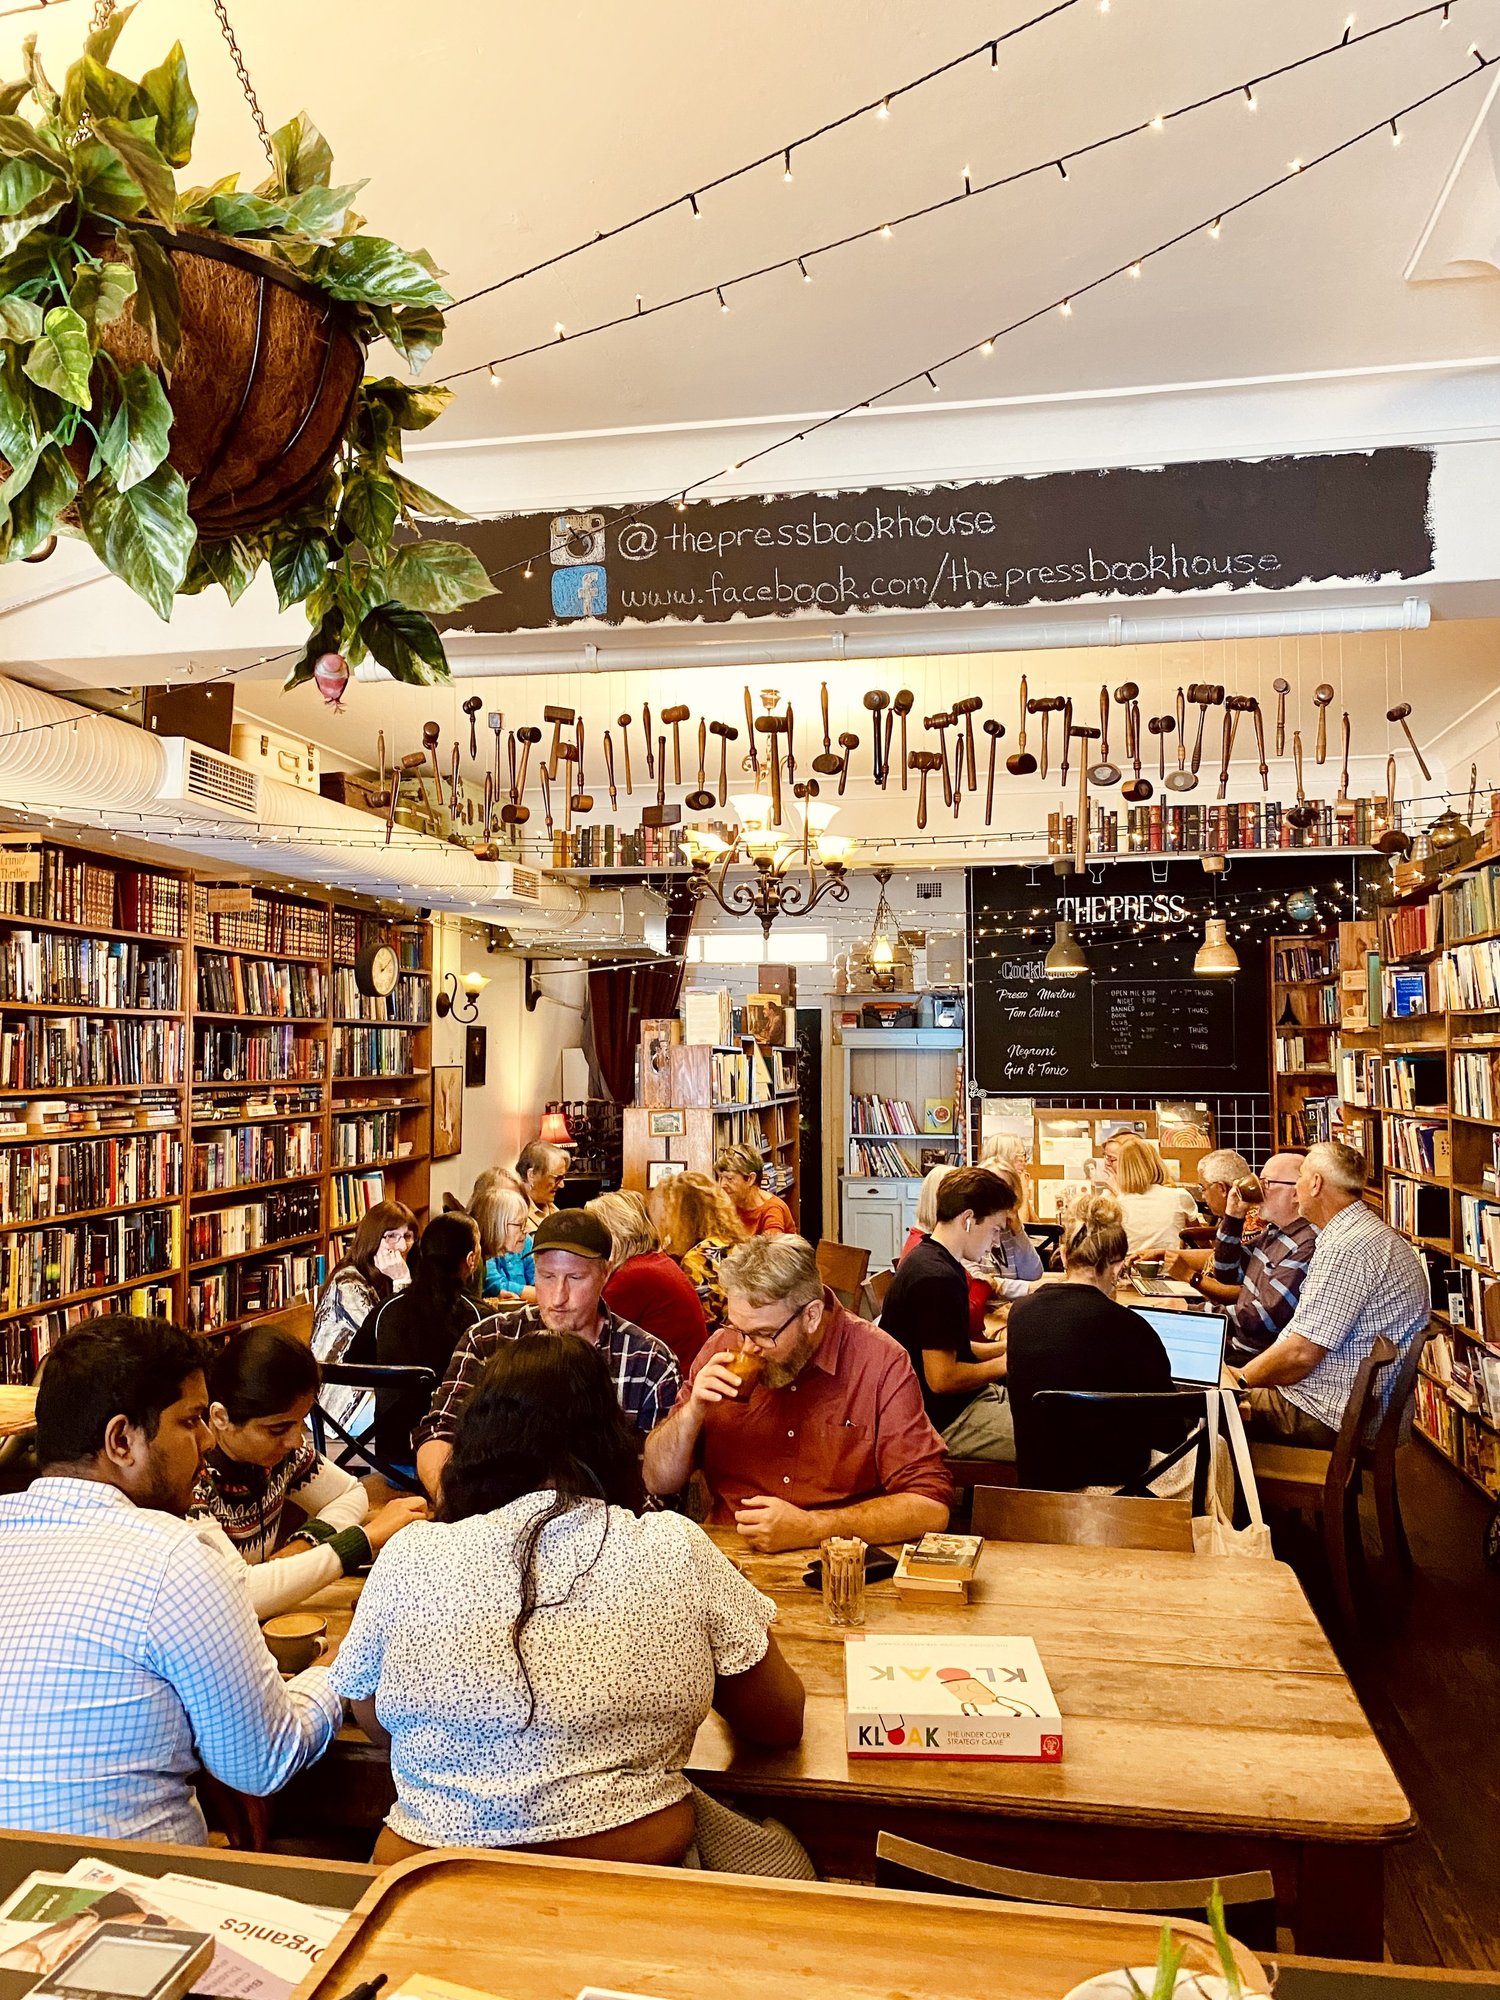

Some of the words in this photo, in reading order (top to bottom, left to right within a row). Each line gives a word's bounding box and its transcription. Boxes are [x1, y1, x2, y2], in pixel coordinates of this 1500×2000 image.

[620, 543, 1283, 609] www.facebook.com/thepressbookhouse
[1056, 896, 1108, 924] THE
[1109, 894, 1185, 923] PRESS
[1036, 988, 1077, 1000] Martini
[1110, 989, 1128, 997] OPEN
[1004, 1007, 1026, 1021] Tom
[1028, 1006, 1061, 1018] Collins
[1187, 1007, 1209, 1015] THURS
[1188, 1026, 1208, 1034] THURS
[1007, 1044, 1057, 1060] Negroni
[1004, 1062, 1024, 1080] Gin
[1027, 1063, 1036, 1076] &
[1037, 1062, 1069, 1076] Tonic
[947, 1730, 959, 1738] THE
[960, 1731, 985, 1739] UNDER
[986, 1731, 1011, 1739] COVER
[947, 1738, 980, 1746] STRATEGY
[981, 1738, 1004, 1746] GAME
